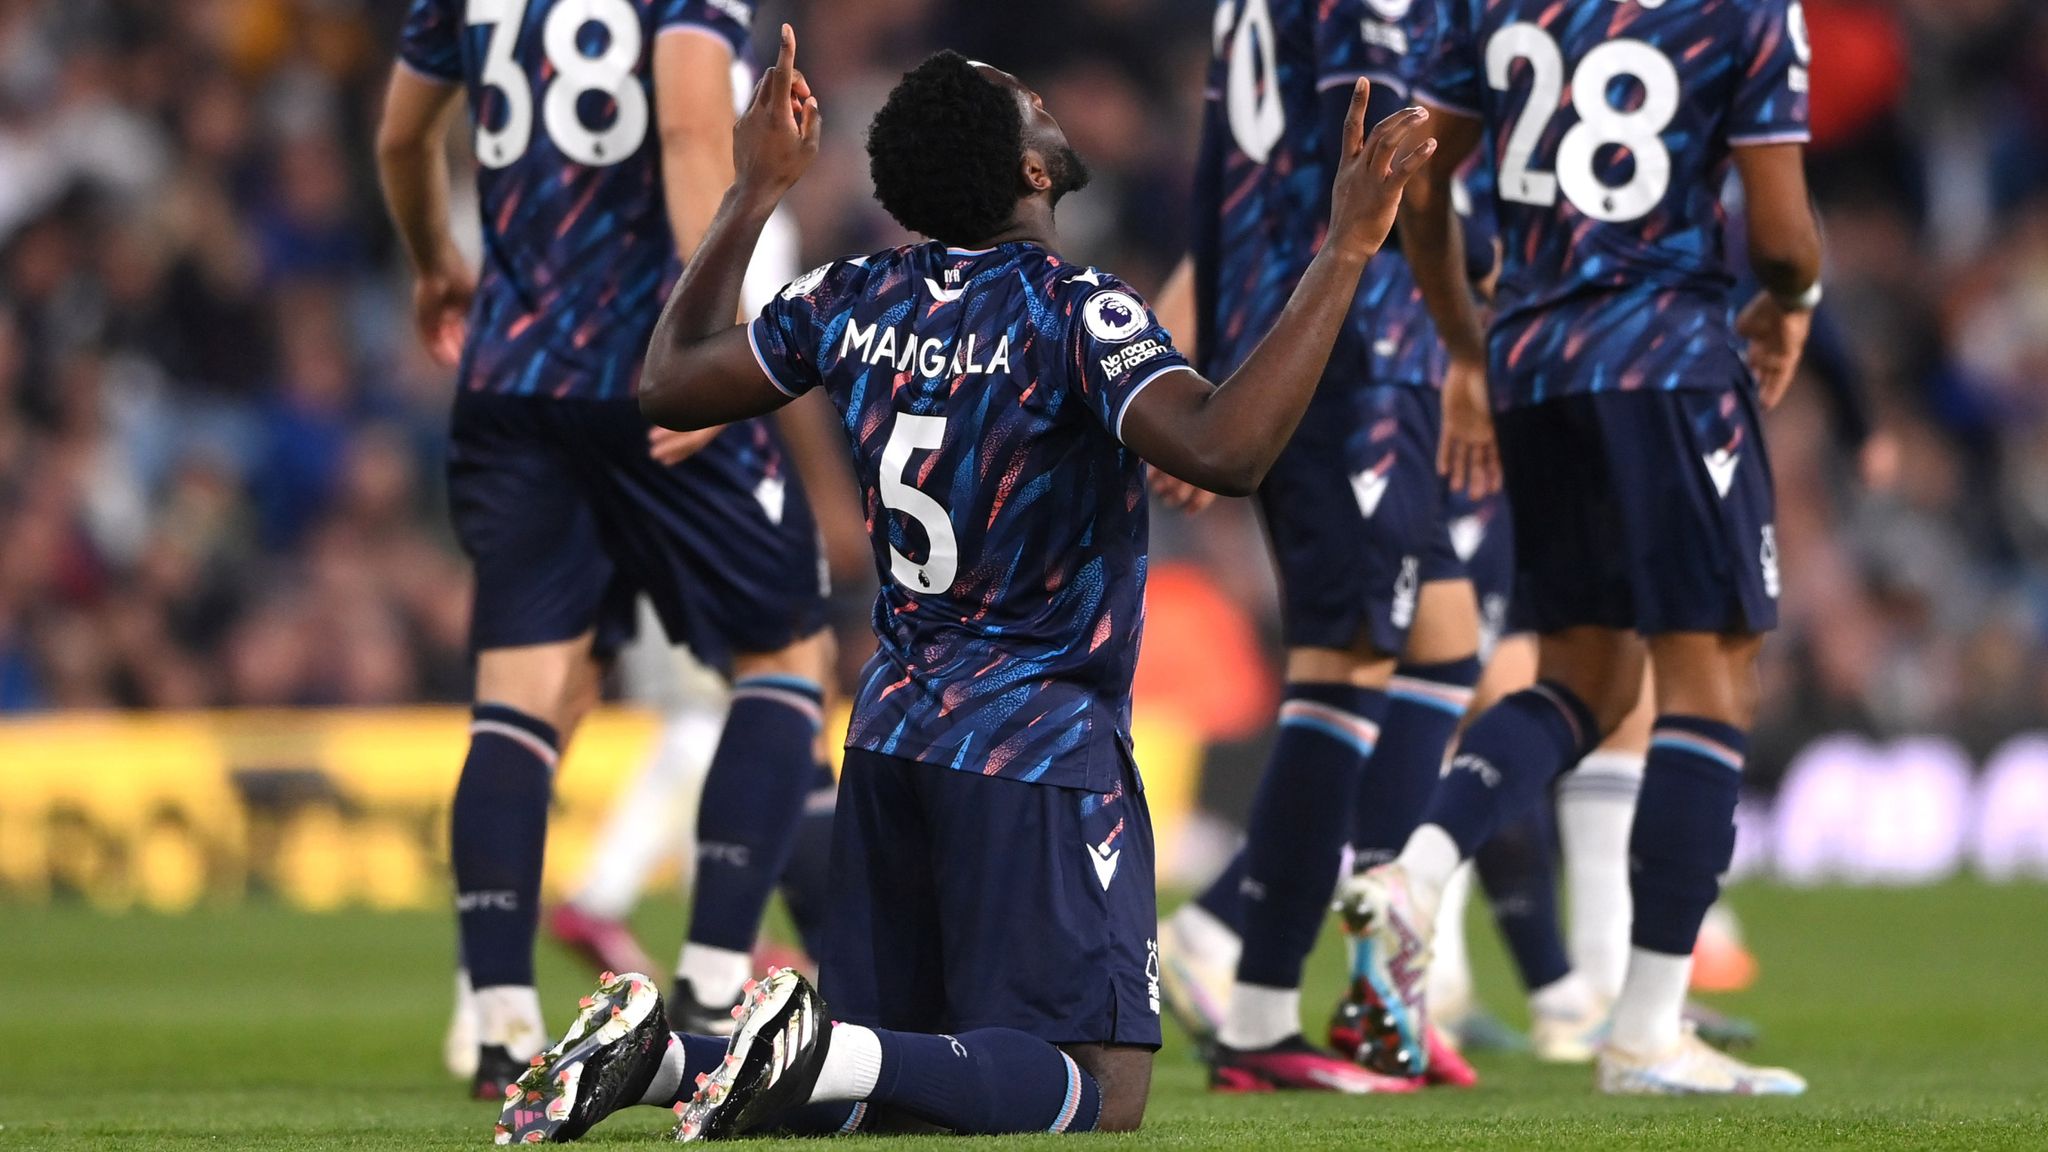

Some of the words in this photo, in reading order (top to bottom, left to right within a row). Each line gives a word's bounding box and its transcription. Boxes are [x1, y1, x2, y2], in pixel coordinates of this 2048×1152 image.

[466, 0, 649, 169] 38
[1486, 22, 1680, 222] 28
[840, 317, 1011, 379] MANGALA
[1100, 354, 1121, 372] No
[1120, 339, 1157, 357] room
[1123, 345, 1168, 370] racism
[879, 411, 958, 594] 5
